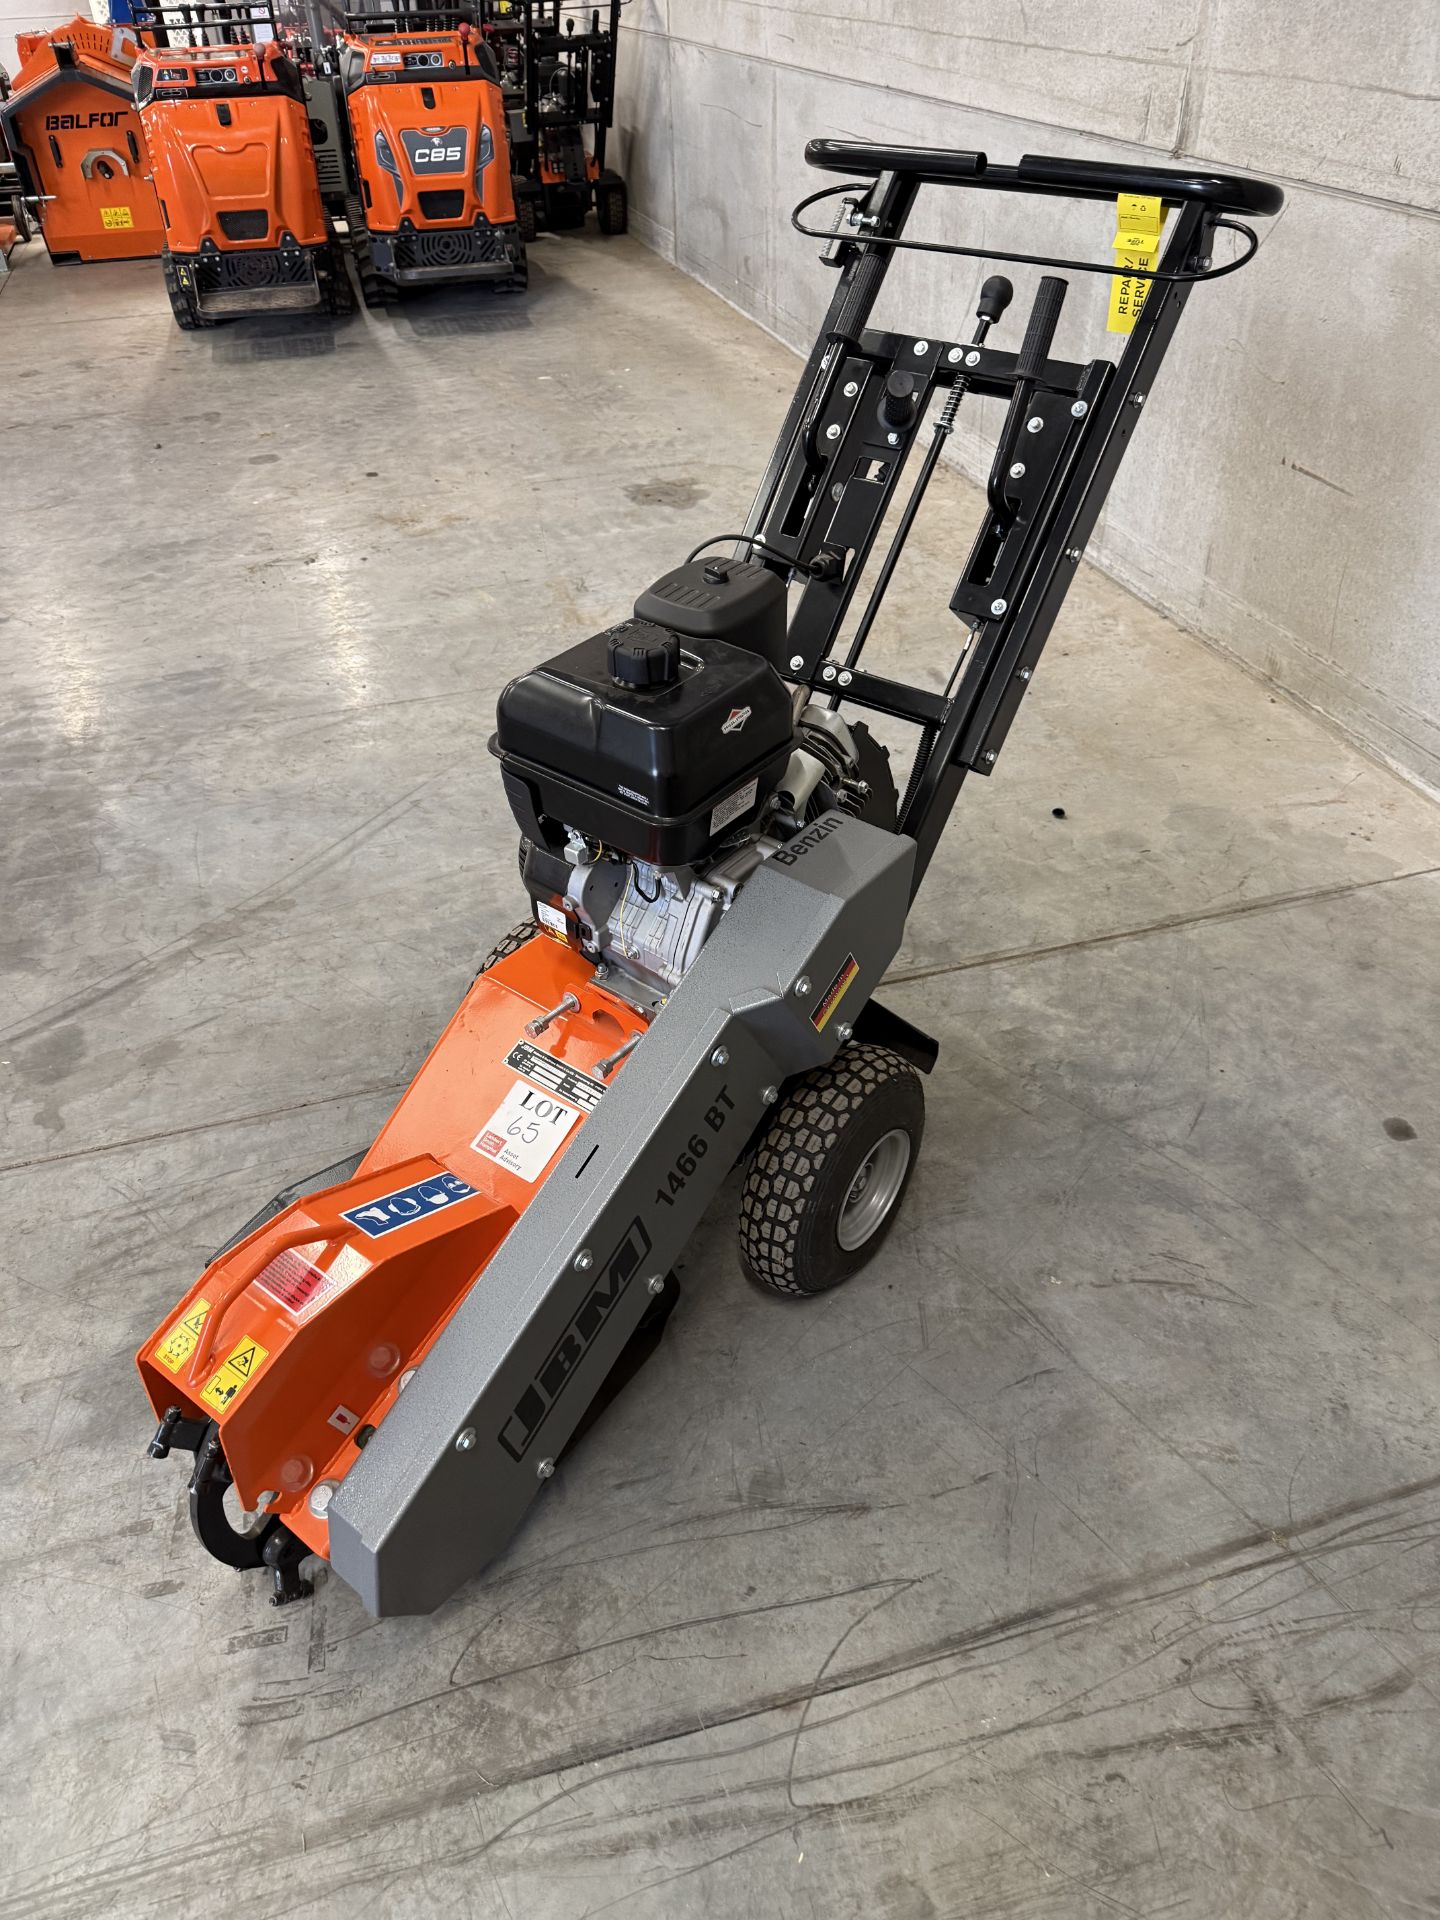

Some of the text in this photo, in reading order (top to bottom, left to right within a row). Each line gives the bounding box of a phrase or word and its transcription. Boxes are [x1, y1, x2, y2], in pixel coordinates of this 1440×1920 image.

[414, 146, 462, 163] C85
[772, 817, 844, 866] Benzin
[518, 1090, 568, 1126] LOT
[506, 1116, 541, 1144] 65
[655, 1083, 736, 1207] 1466 BT
[499, 1154, 522, 1171] Advisory
[504, 1148, 519, 1160] Asset
[510, 1235, 642, 1448] JBM
